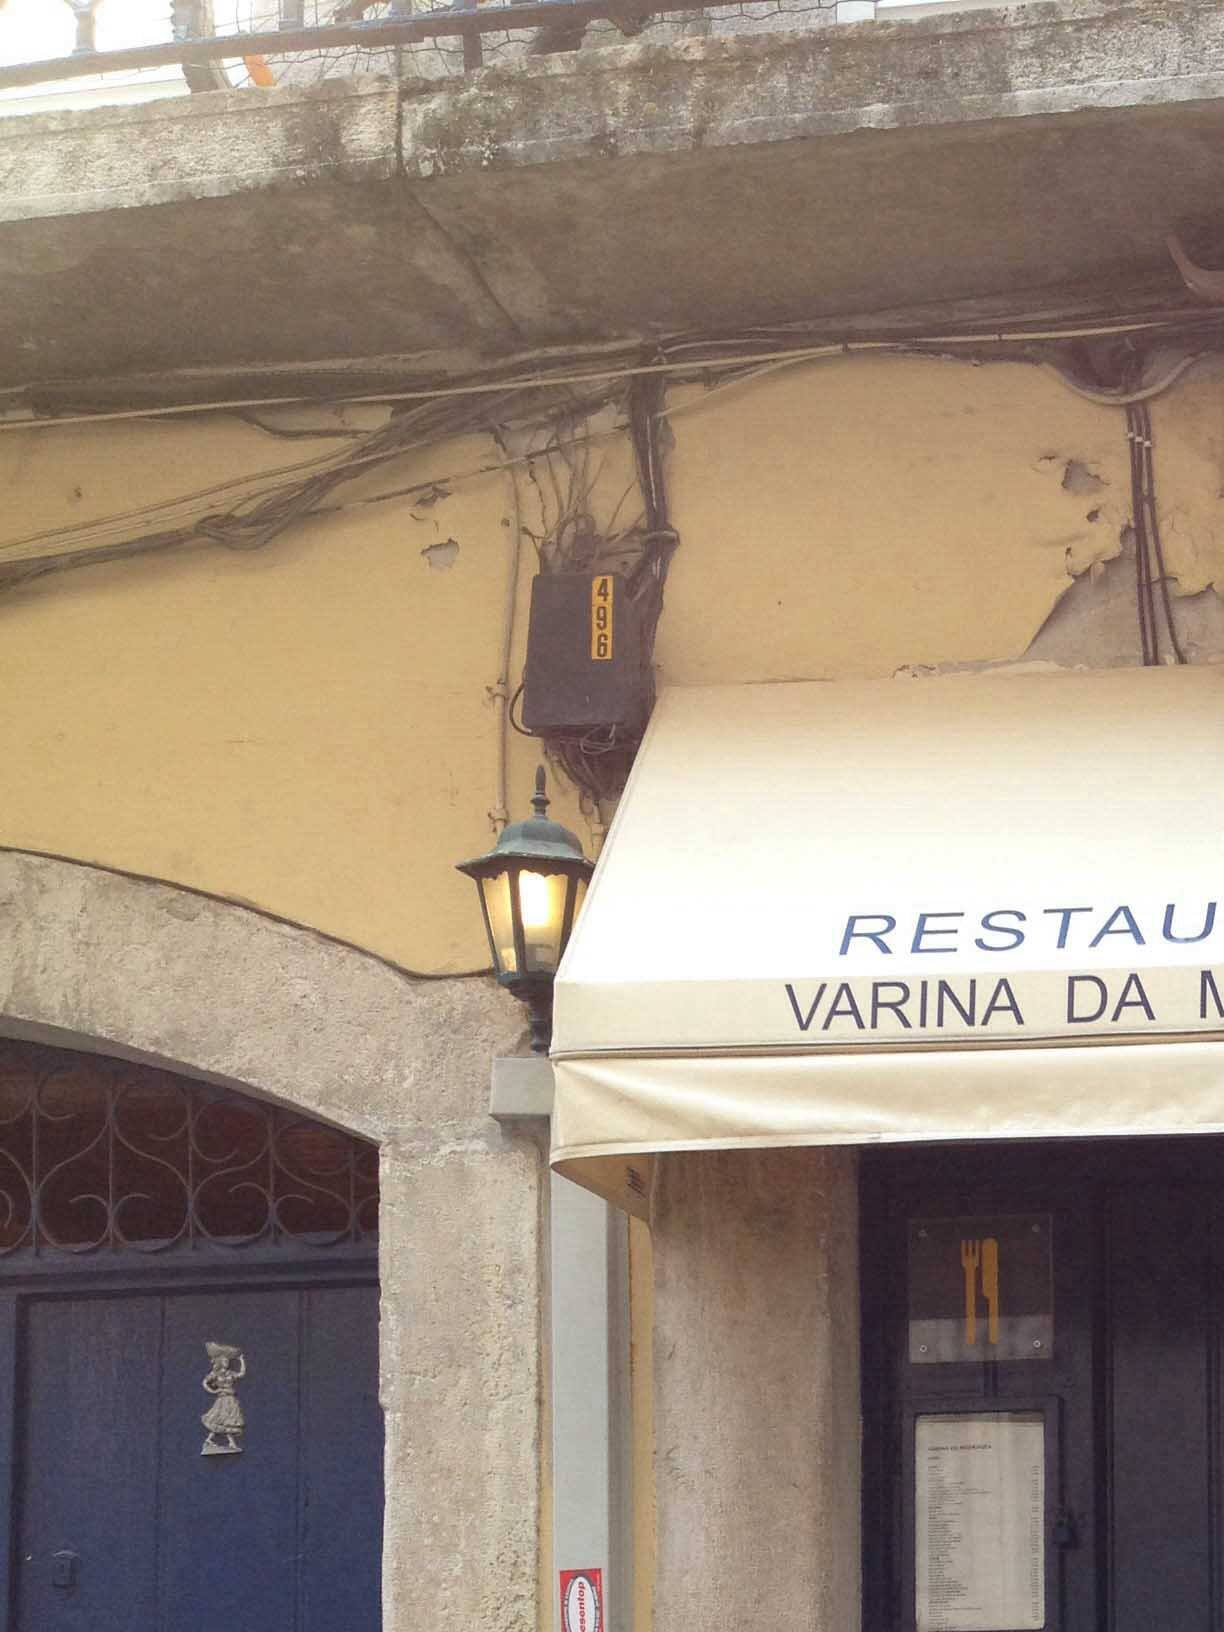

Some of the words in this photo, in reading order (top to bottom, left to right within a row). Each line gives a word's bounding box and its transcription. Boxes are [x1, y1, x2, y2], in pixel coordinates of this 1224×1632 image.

[596, 578, 610, 658] 496
[785, 977, 1025, 1032] VARINA
[1066, 973, 1156, 1025] DA
